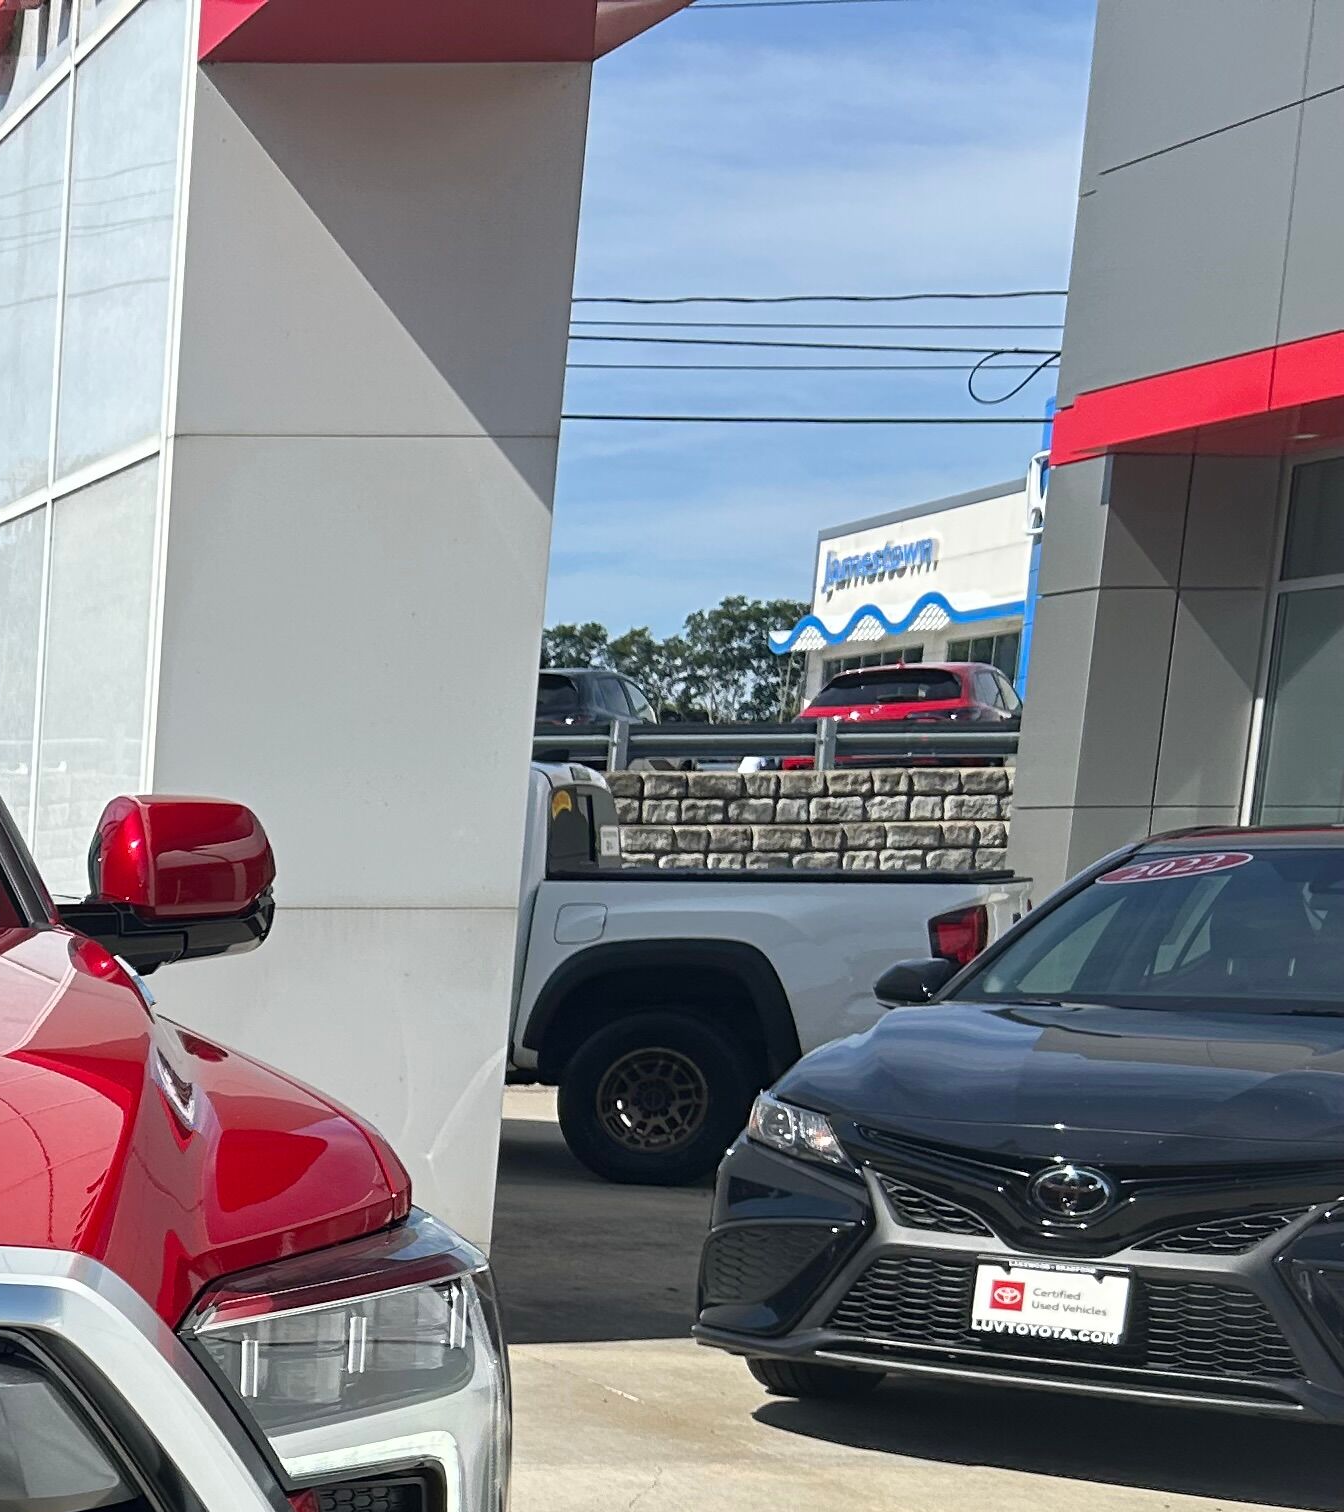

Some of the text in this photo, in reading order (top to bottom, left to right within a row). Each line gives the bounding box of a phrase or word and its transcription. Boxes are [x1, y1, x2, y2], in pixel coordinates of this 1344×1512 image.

[1120, 855, 1226, 880] 2022
[1033, 1287, 1081, 1301] Certified
[1031, 1300, 1107, 1317] Used Vehicles
[971, 1319, 1121, 1345] LUVTOYOTA.COM
